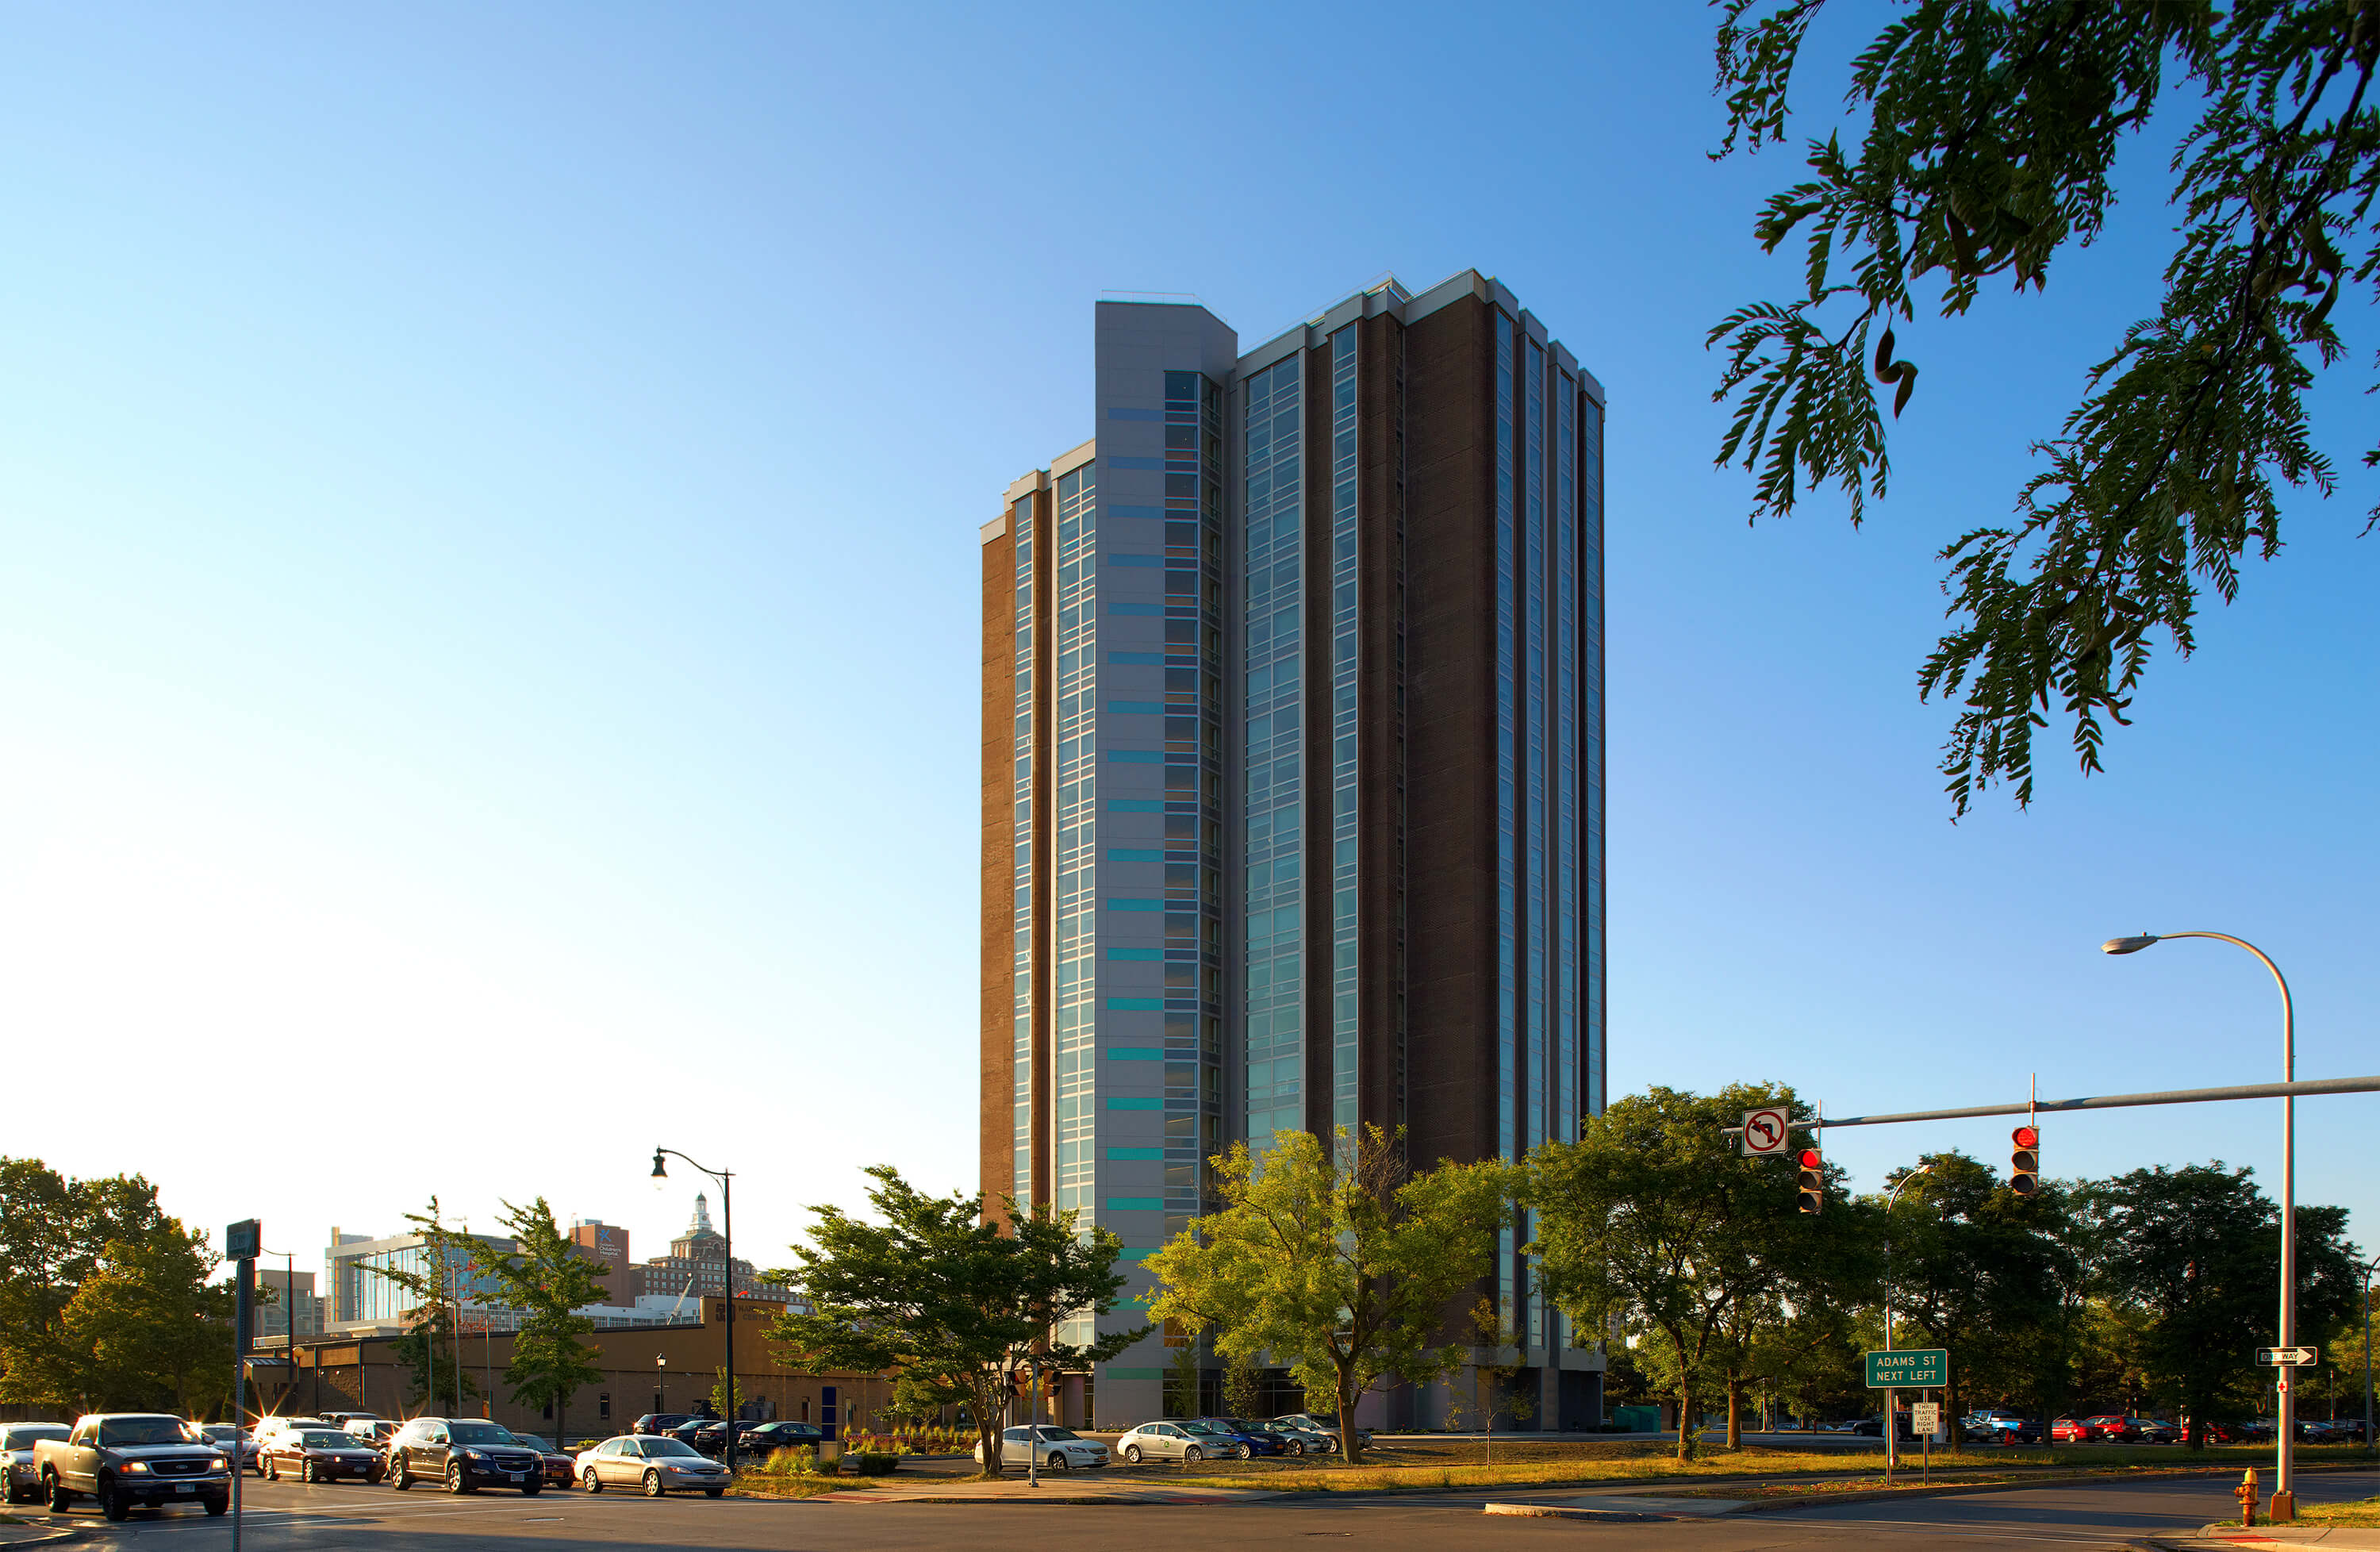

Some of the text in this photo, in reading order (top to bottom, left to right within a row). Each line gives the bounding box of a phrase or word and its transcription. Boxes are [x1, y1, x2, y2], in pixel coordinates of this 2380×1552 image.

[1876, 1356, 1937, 1366] ADAMS ST
[1877, 1370, 1937, 1381] NEXT LEFT
